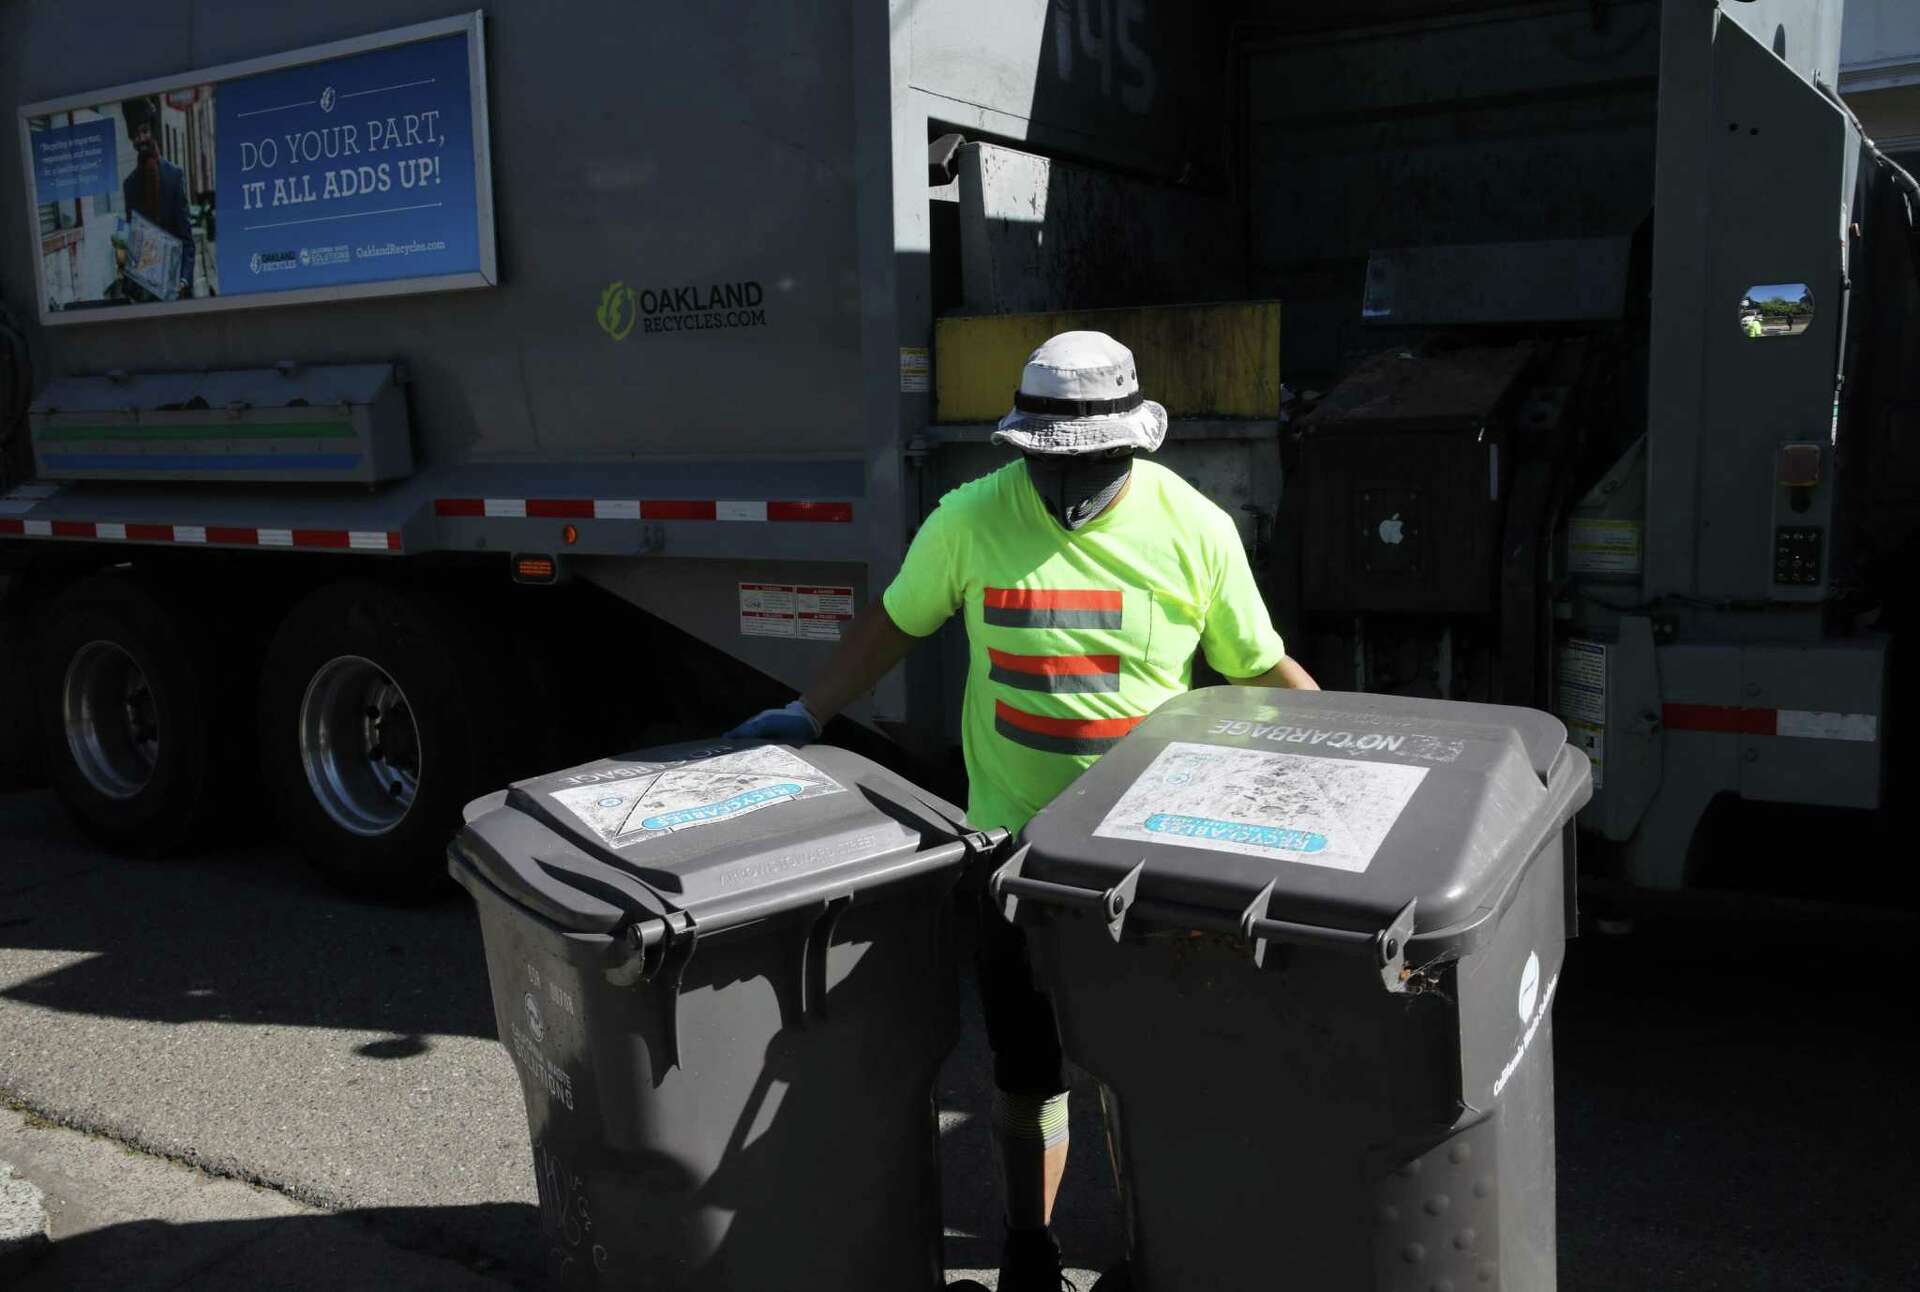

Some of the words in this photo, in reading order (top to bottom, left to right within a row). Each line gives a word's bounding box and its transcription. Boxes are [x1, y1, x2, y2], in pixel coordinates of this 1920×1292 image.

[240, 138, 278, 172] DO
[285, 124, 360, 164] YOUR
[367, 110, 446, 152] PART,
[241, 181, 266, 210] IT
[272, 175, 317, 207] ALL
[322, 161, 391, 200] ADDS
[397, 156, 442, 189] UP!
[640, 281, 763, 314] OAKLAND
[643, 310, 768, 333] RECYCLES.COM
[656, 789, 789, 825] RECYCLABLES
